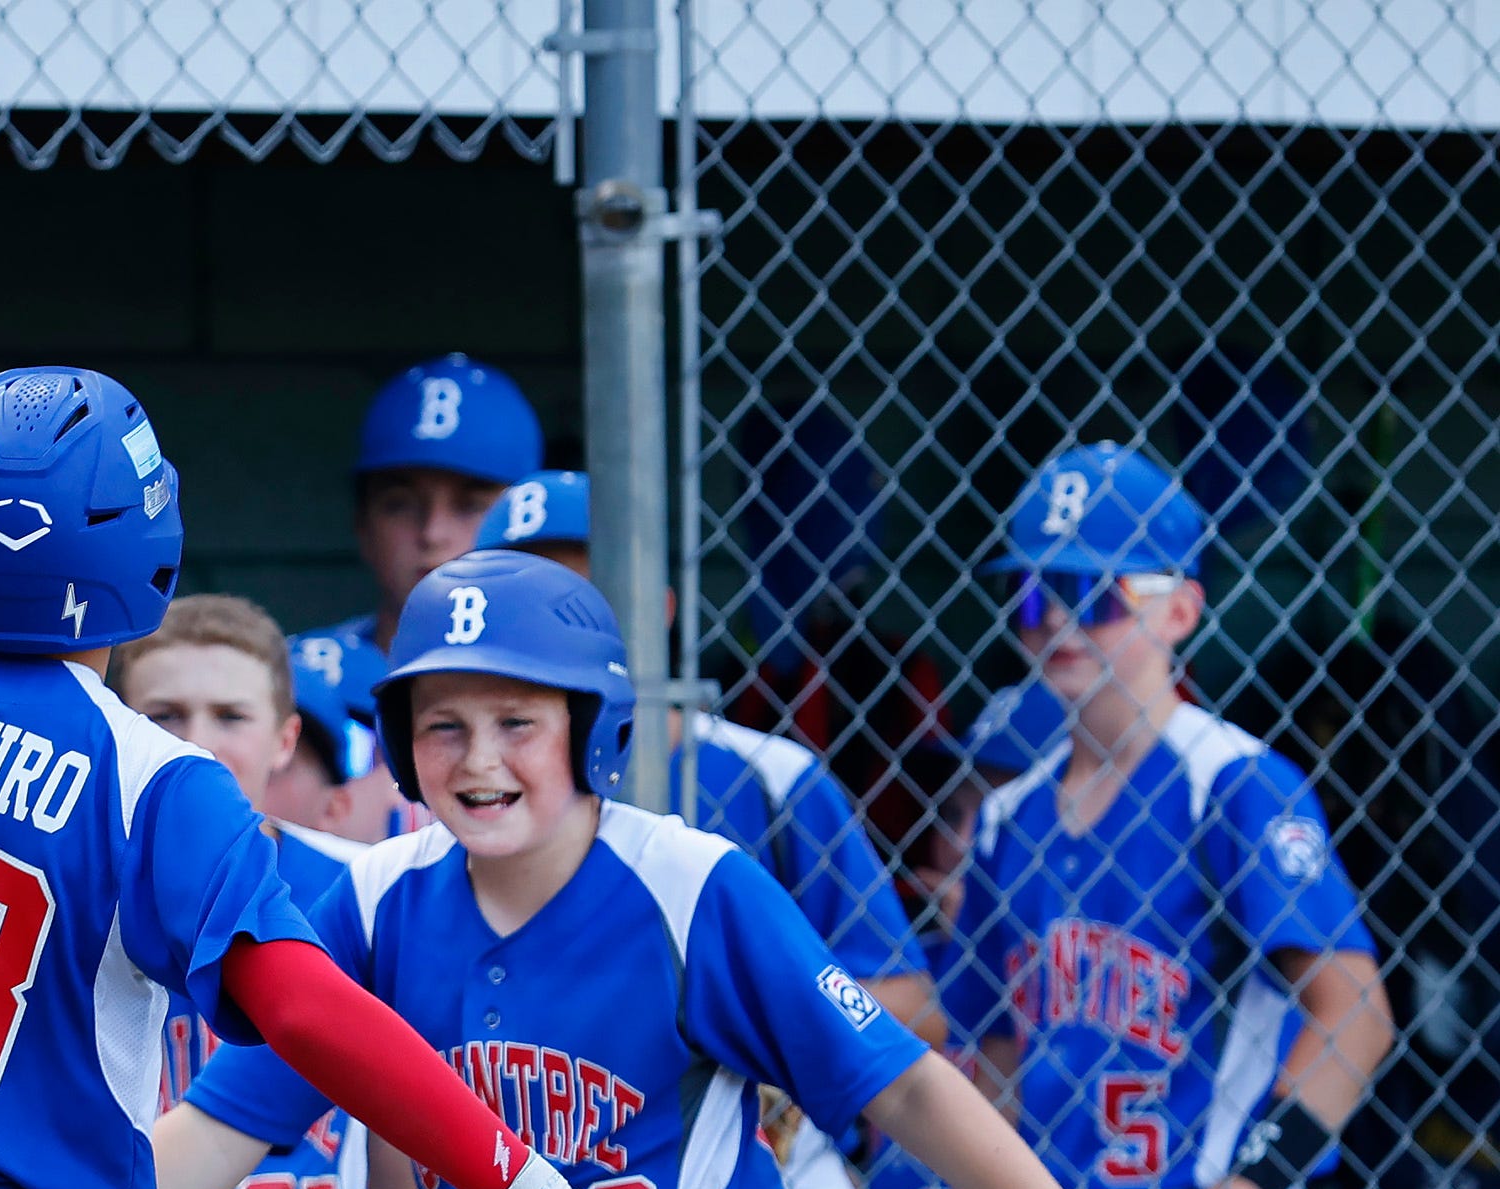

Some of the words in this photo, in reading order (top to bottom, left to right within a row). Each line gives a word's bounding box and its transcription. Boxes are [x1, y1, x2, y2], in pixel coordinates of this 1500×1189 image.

[411, 377, 462, 440] B
[503, 481, 548, 541] B
[1041, 470, 1090, 537] B
[444, 586, 488, 645] B
[1097, 1071, 1169, 1189] 5
